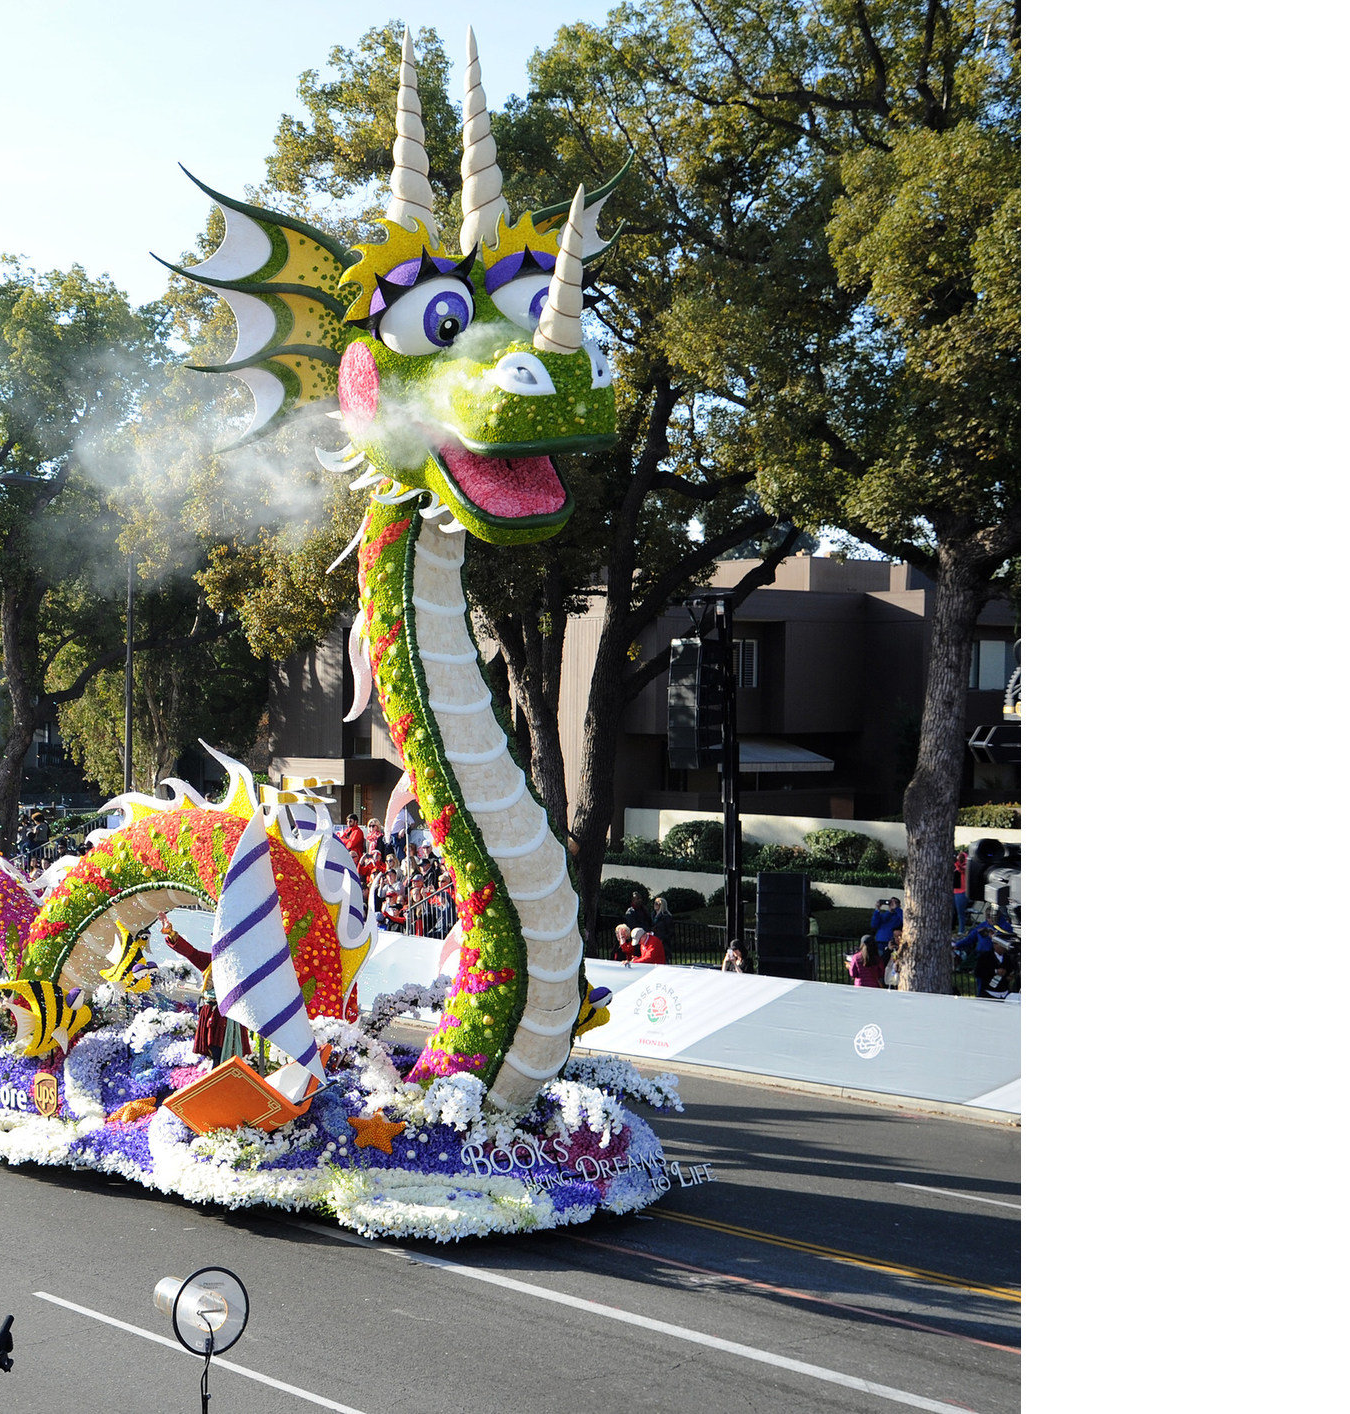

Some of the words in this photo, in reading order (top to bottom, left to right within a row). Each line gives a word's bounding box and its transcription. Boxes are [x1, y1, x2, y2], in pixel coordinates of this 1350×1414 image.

[633, 985, 653, 1015] ROSE
[655, 982, 683, 1020] PARADE
[638, 1038, 669, 1048] HONDA
[460, 1138, 569, 1179] BOOKS
[525, 1170, 573, 1193] BRING
[575, 1149, 667, 1183] DREAMS
[648, 1175, 671, 1192] TO
[671, 1161, 718, 1189] LIFE
